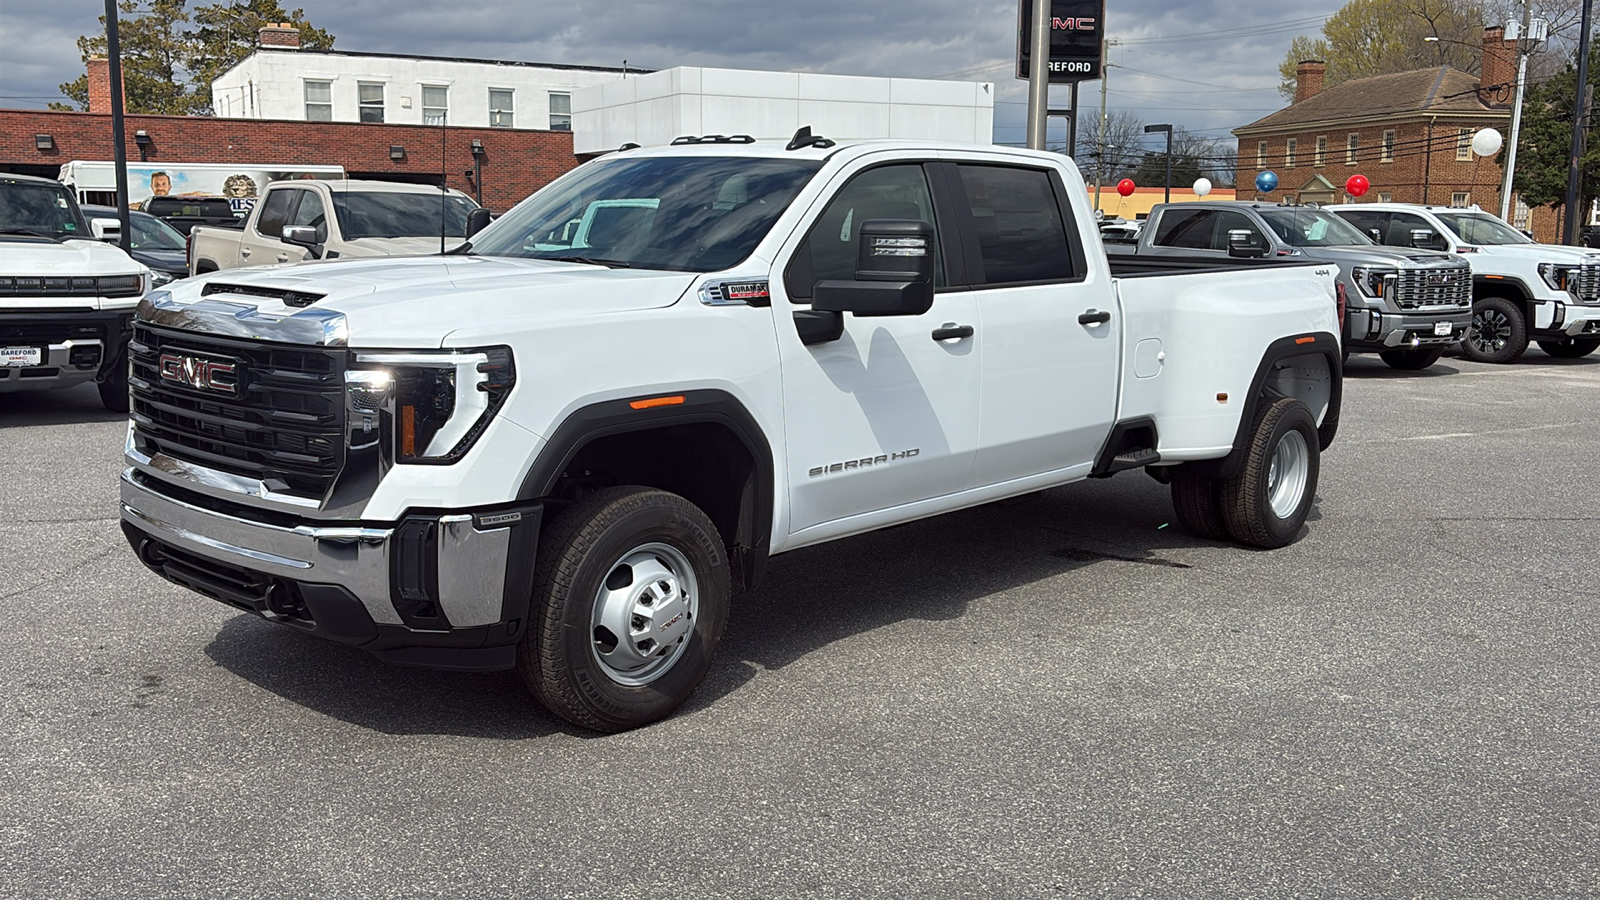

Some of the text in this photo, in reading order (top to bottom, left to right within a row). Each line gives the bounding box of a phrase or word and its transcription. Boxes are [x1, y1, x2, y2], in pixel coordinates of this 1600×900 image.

[1050, 17, 1095, 30] MC
[730, 284, 767, 293] DURAMAX
[160, 353, 236, 393] GMC
[808, 448, 920, 477] SIERRA HD
